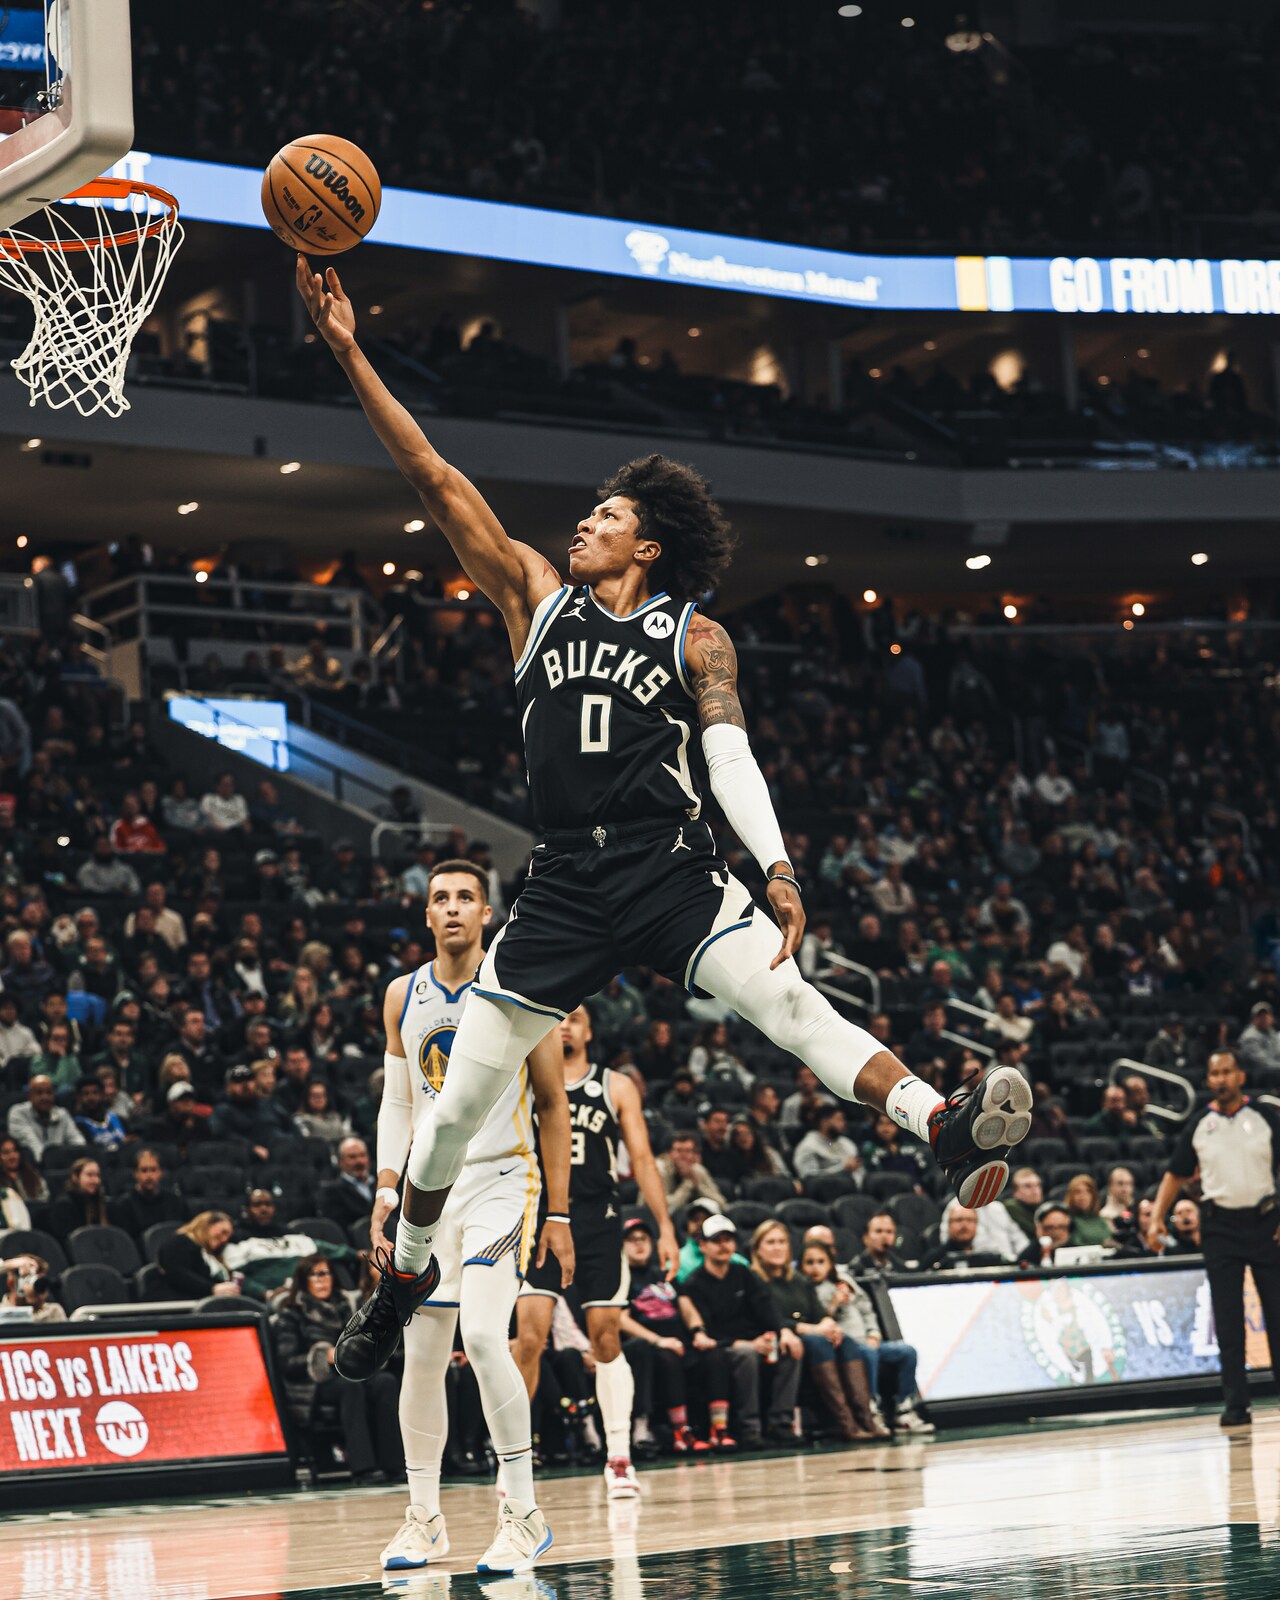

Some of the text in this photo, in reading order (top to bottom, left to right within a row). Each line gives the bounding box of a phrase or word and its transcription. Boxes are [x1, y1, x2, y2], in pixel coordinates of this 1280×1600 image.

[305, 153, 365, 223] Wilson
[1050, 257, 1103, 312] GO
[1109, 258, 1215, 313] FROM
[541, 639, 673, 706] BUCKS
[580, 693, 612, 753] 0
[418, 1017, 453, 1040] GOLDEN
[89, 1341, 199, 1396] LAKERS
[9, 1407, 87, 1462] NEXT
